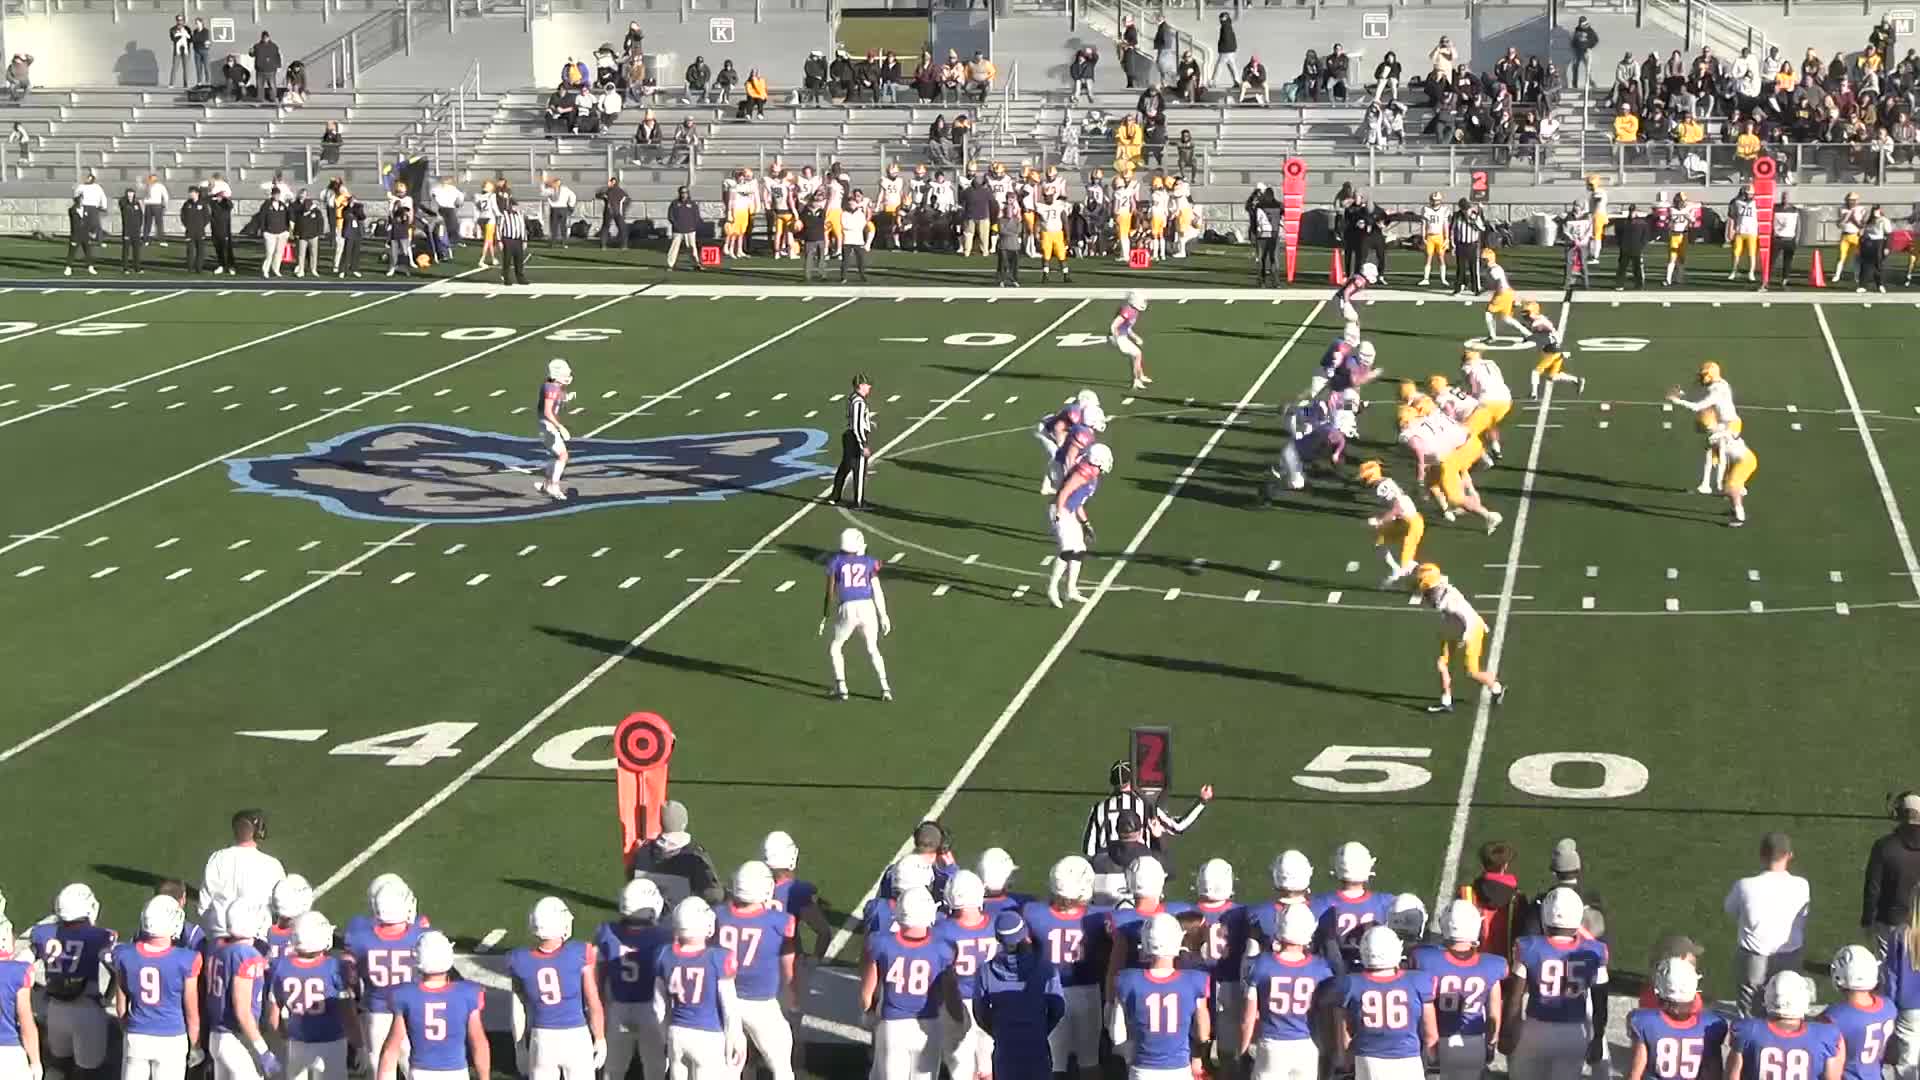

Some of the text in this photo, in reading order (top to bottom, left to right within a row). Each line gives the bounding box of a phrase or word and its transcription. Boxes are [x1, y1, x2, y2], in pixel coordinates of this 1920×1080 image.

[219, 27, 228, 40] J
[716, 27, 727, 40] K
[1371, 24, 1380, 36] L
[1471, 171, 1488, 191] 2
[702, 249, 716, 262] 30
[1131, 252, 1147, 265] 40
[841, 563, 867, 588] 12
[1138, 735, 1165, 784] 2
[1291, 744, 1651, 799] 50
[45, 938, 84, 974] 27
[618, 945, 639, 983] 5
[719, 925, 762, 967] 97
[955, 937, 999, 976] 57
[139, 966, 161, 1005] 9
[367, 949, 412, 987] 55
[536, 967, 562, 1005] 9
[669, 966, 705, 1005] 47
[886, 957, 930, 996] 48
[1538, 958, 1588, 999] 95
[282, 976, 326, 1016] 26
[1145, 992, 1178, 1033] 11
[1269, 976, 1315, 1015] 59
[1361, 989, 1408, 1030] 96
[1439, 975, 1487, 1013] 62
[424, 1002, 447, 1041] 5
[1656, 1037, 1704, 1079] 85
[1759, 1047, 1809, 1080] 68
